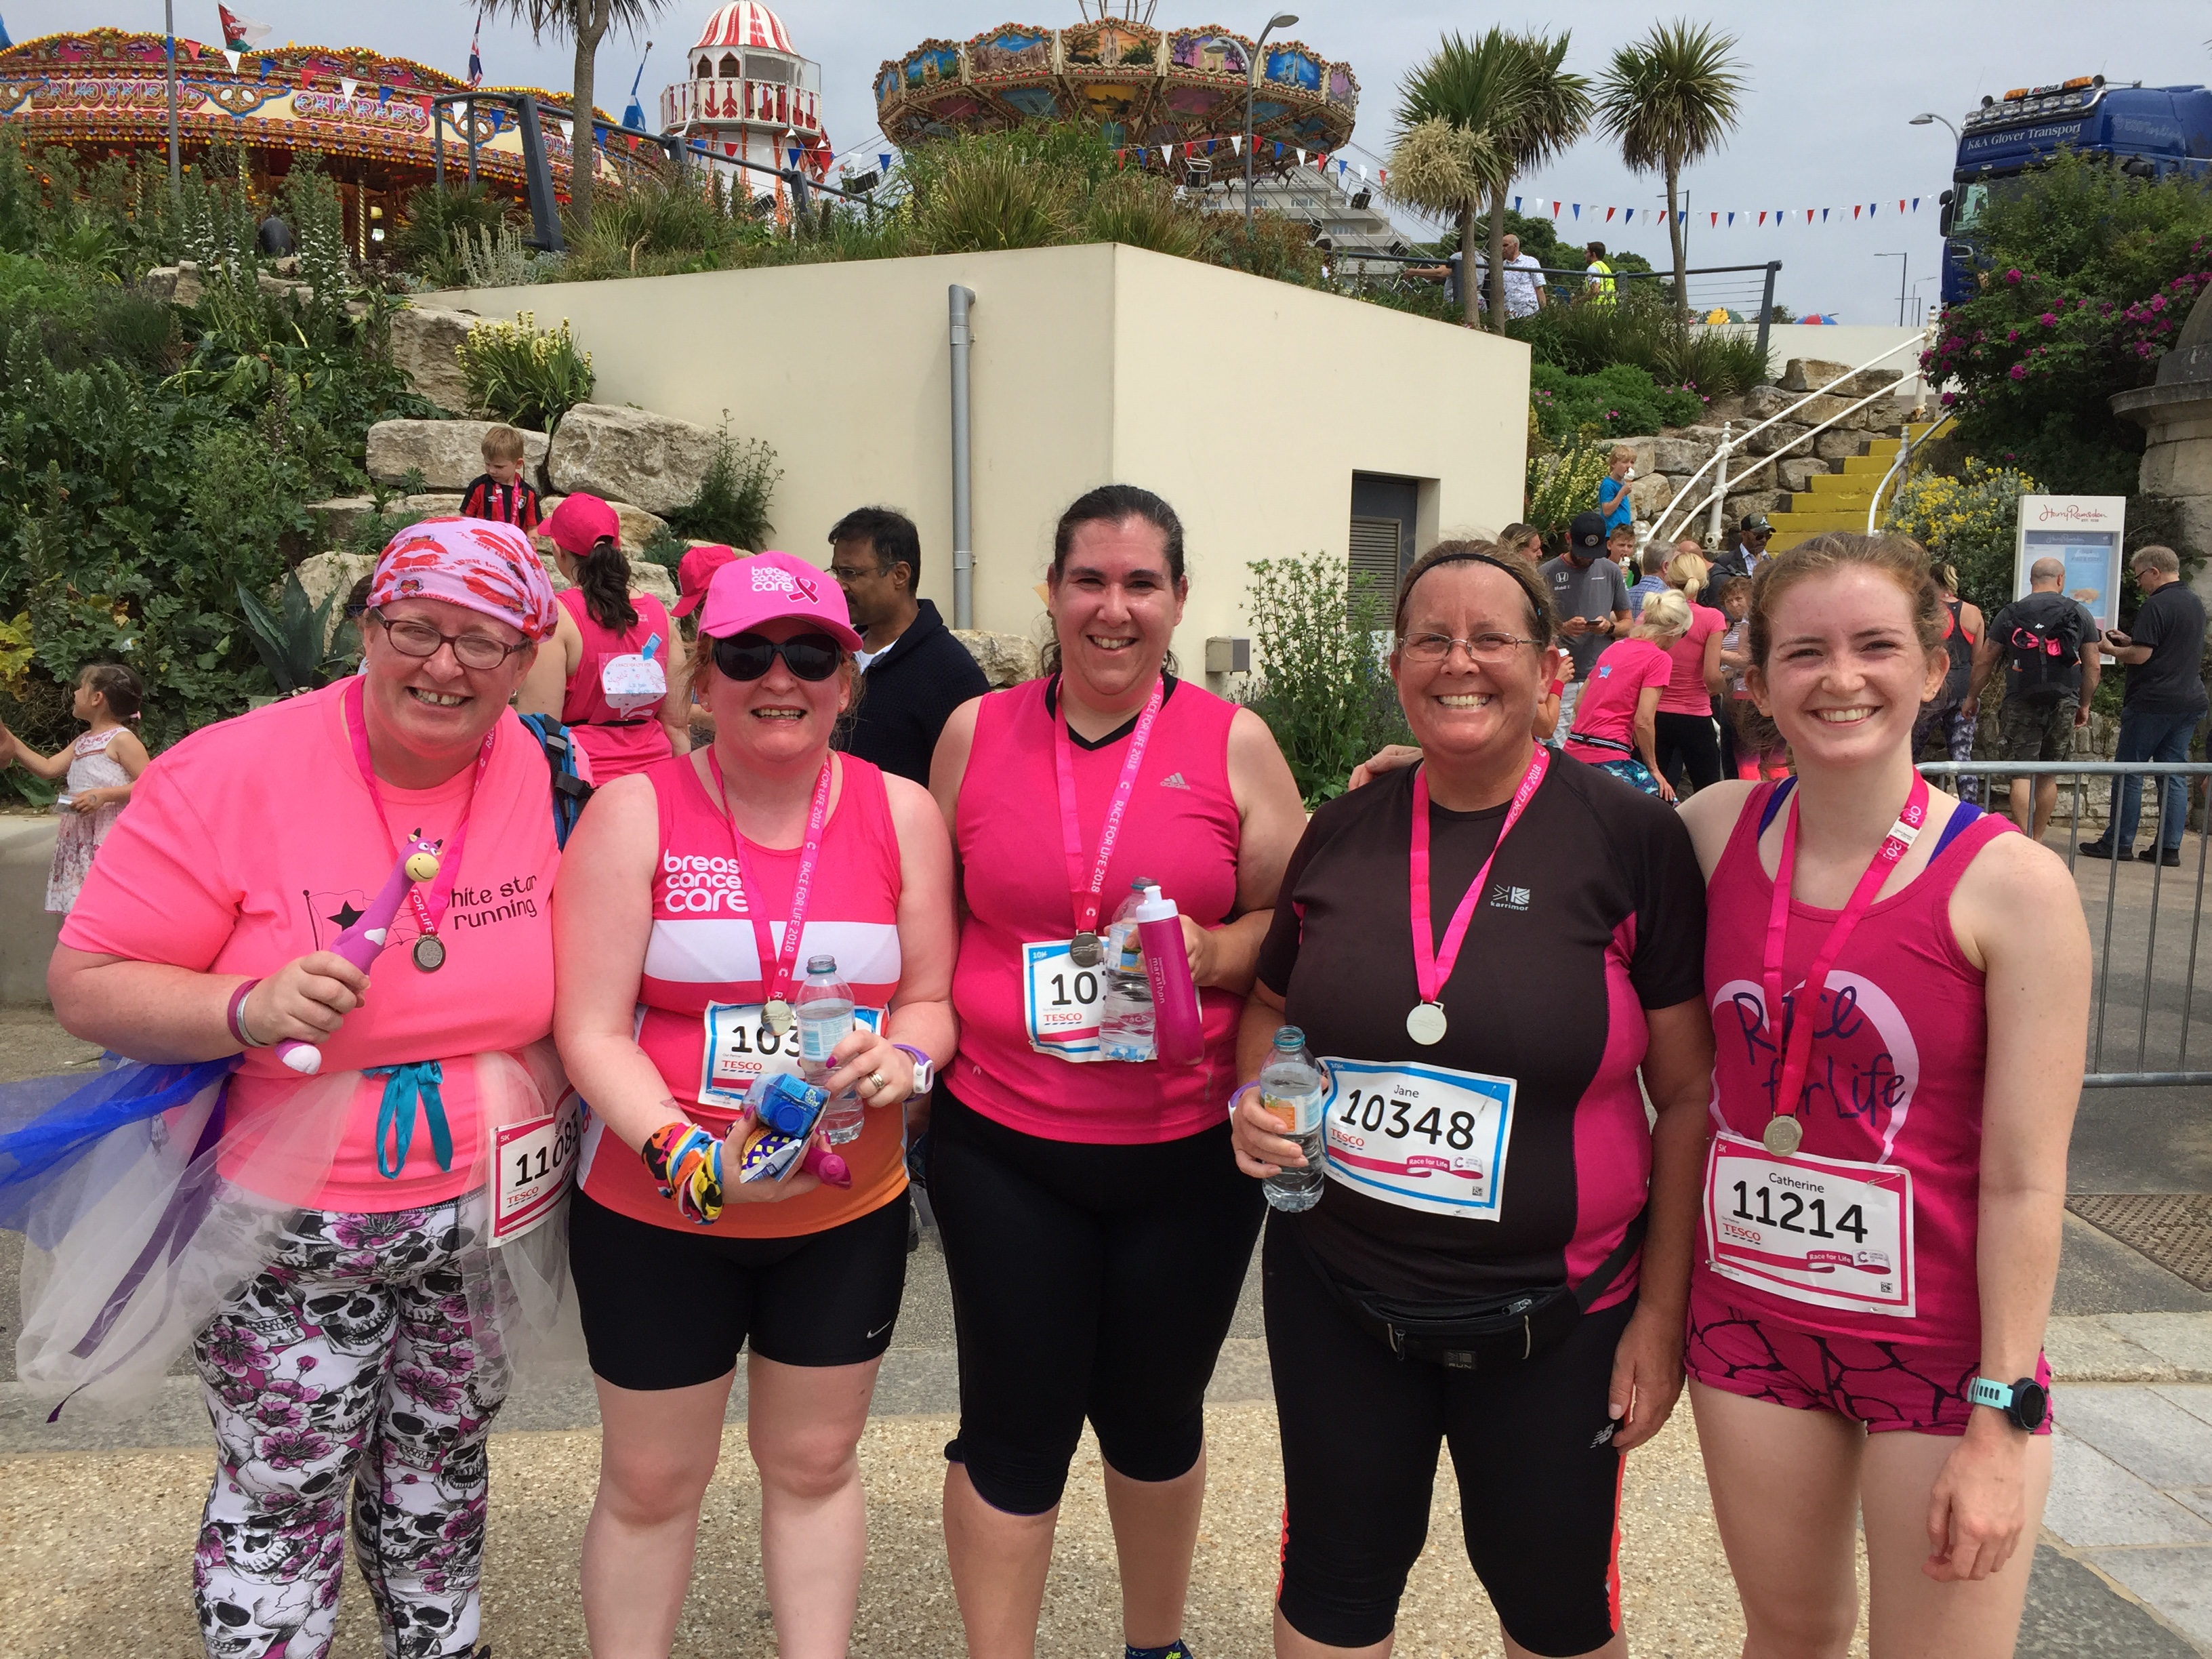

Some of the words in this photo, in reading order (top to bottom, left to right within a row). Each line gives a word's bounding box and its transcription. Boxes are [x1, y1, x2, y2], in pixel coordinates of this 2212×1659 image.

[31, 81, 207, 111] ENJOYMENT
[289, 93, 430, 134] CHARLES
[1967, 138, 1988, 150] K&A
[1991, 131, 2025, 145] Glover
[2028, 123, 2082, 140] Transport
[2039, 504, 2068, 521] Harry
[2067, 504, 2108, 519] Ramsden
[752, 581, 794, 592] care
[1146, 693, 1161, 714] RACE
[1141, 713, 1153, 731] FOR
[1134, 731, 1149, 748] LIFE
[1127, 747, 1141, 771] 2018
[820, 769, 830, 789] FOR
[815, 787, 826, 807] LIFE
[1510, 800, 1521, 821] FOR
[1518, 782, 1533, 803] LIFE
[1528, 764, 1542, 785] 2018
[811, 806, 823, 830] 2018
[1109, 800, 1124, 825] RACE
[1103, 824, 1117, 846] FOR
[664, 848, 740, 874] breas
[1097, 846, 1111, 867] LIFE
[666, 872, 742, 890] cance
[798, 860, 813, 886] RACE
[1090, 867, 1105, 893] 2018
[446, 886, 493, 909] hite
[500, 875, 537, 898] star
[665, 888, 749, 913] care
[794, 886, 806, 906] FOR
[410, 888, 426, 911] FOR
[420, 913, 435, 933] LIFE
[454, 899, 537, 930] running
[790, 907, 805, 927] LIFE
[1490, 901, 1529, 911] karrimor
[784, 928, 799, 953] 2018
[1051, 970, 1107, 1005] 10
[1152, 957, 1165, 1004] marathon
[1044, 1012, 1082, 1022] TESCO
[1733, 986, 1863, 1066] Re
[731, 1025, 800, 1058] 103
[722, 1060, 762, 1071] TESCO
[1393, 1084, 1419, 1099] Jane
[1762, 1058, 1824, 1116] fr
[1828, 1053, 1906, 1126] Life
[1339, 1088, 1475, 1150] 10348
[500, 1134, 510, 1143] 5K
[1330, 1127, 1365, 1147] TESCO
[1718, 1143, 1727, 1153] 5K
[1436, 1160, 1448, 1169] Life
[1769, 1172, 1825, 1194] Catherine
[507, 1186, 539, 1205] TESCO
[1732, 1181, 1868, 1244] 11214
[1722, 1223, 1761, 1242] TESCO
[1838, 1254, 1851, 1263] Life
